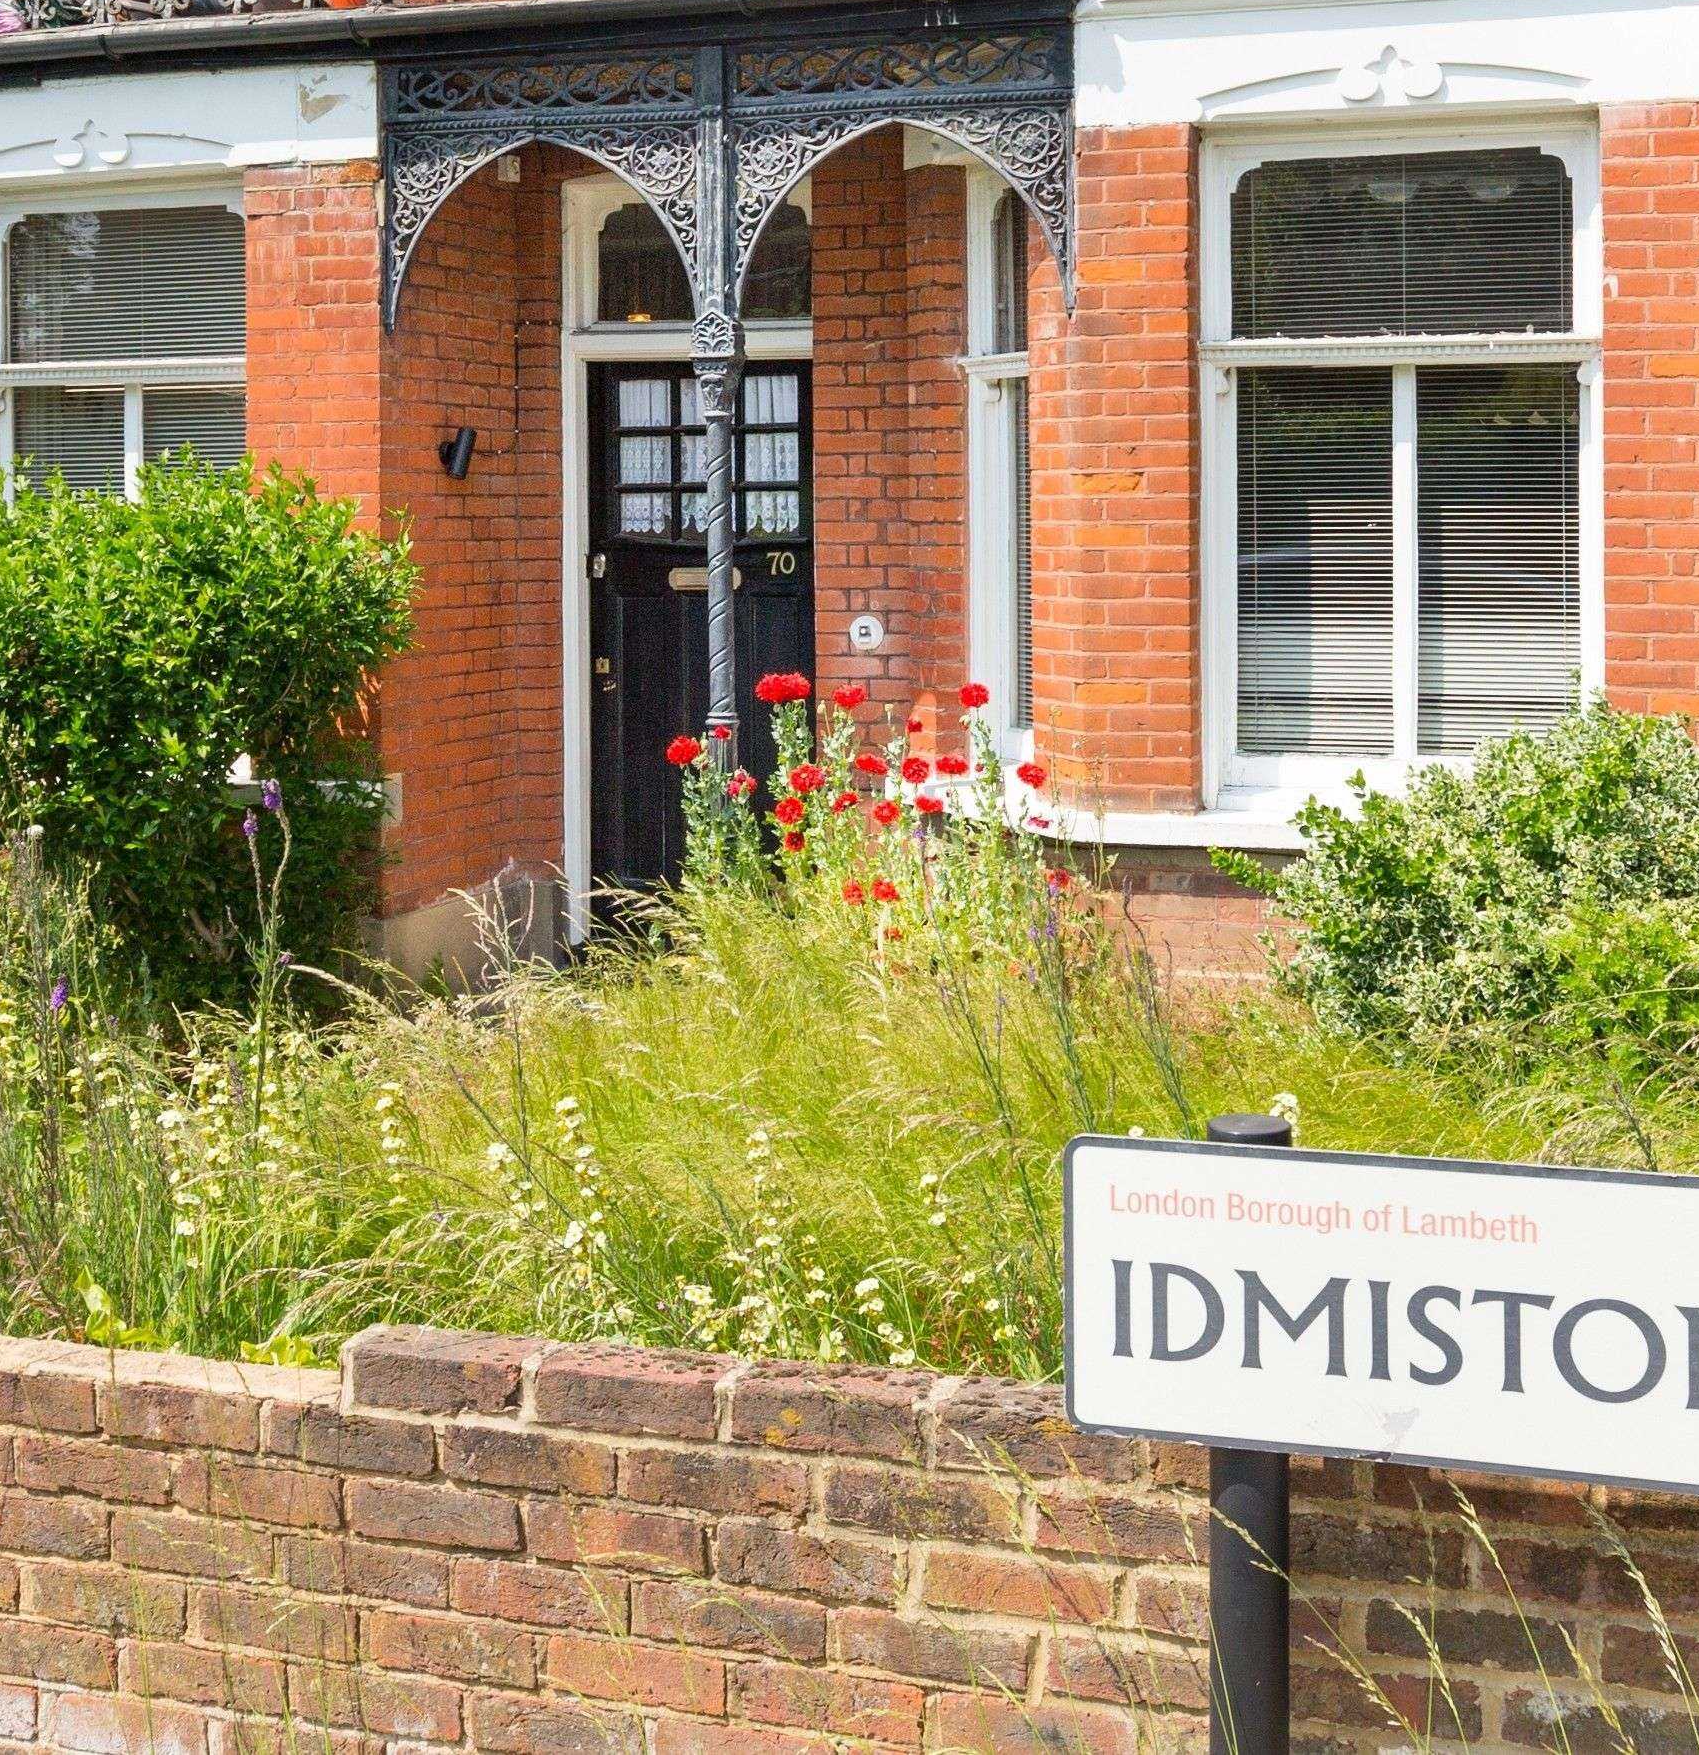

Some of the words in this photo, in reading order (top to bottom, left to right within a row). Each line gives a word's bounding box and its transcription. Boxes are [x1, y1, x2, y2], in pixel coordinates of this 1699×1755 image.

[766, 551, 795, 575] 70
[1109, 1184, 1216, 1219] London
[1226, 1193, 1352, 1234] Borough
[1362, 1203, 1393, 1232] of
[1402, 1206, 1539, 1245] Lambeth
